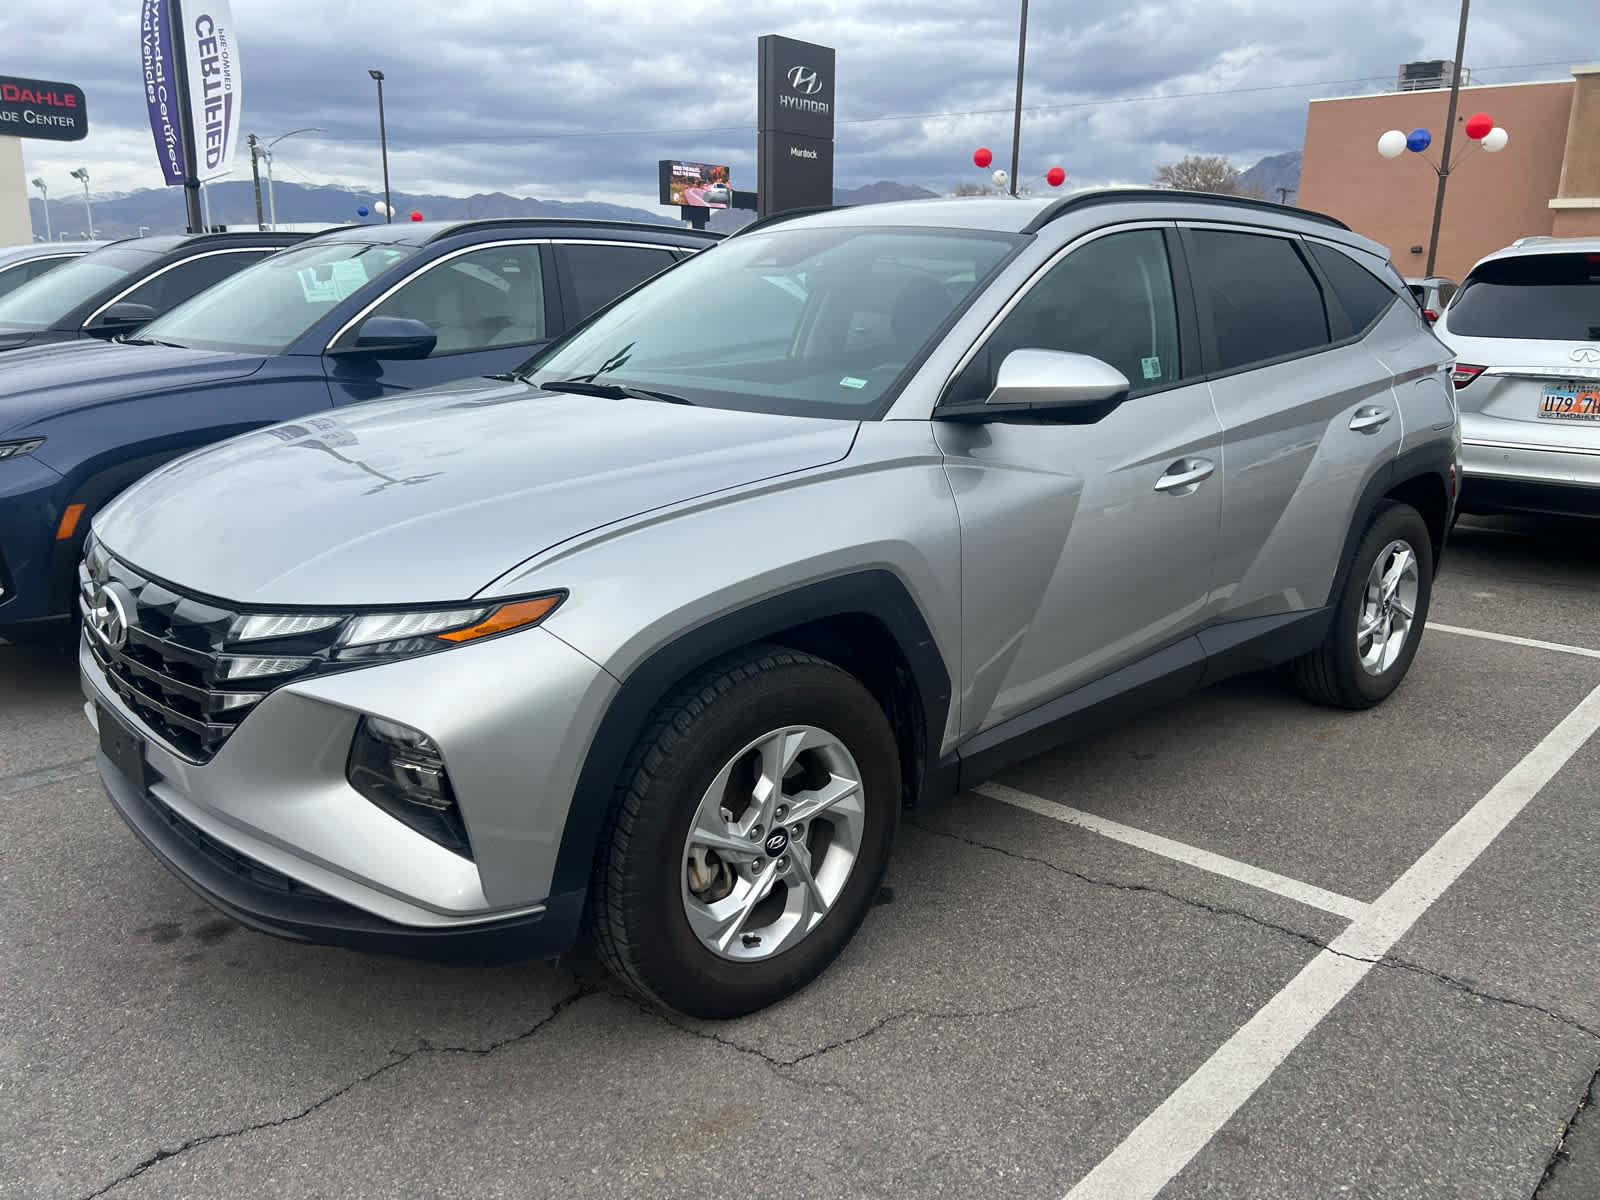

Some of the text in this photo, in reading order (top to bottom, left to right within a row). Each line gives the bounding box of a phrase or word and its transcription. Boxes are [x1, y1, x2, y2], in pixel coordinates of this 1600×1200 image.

[143, 0, 156, 104] sed Vehicles
[0, 84, 77, 107] DAHLE
[780, 95, 829, 113] HYUNDAI
[0, 109, 75, 128] DE CENTER
[159, 85, 182, 175] Certified
